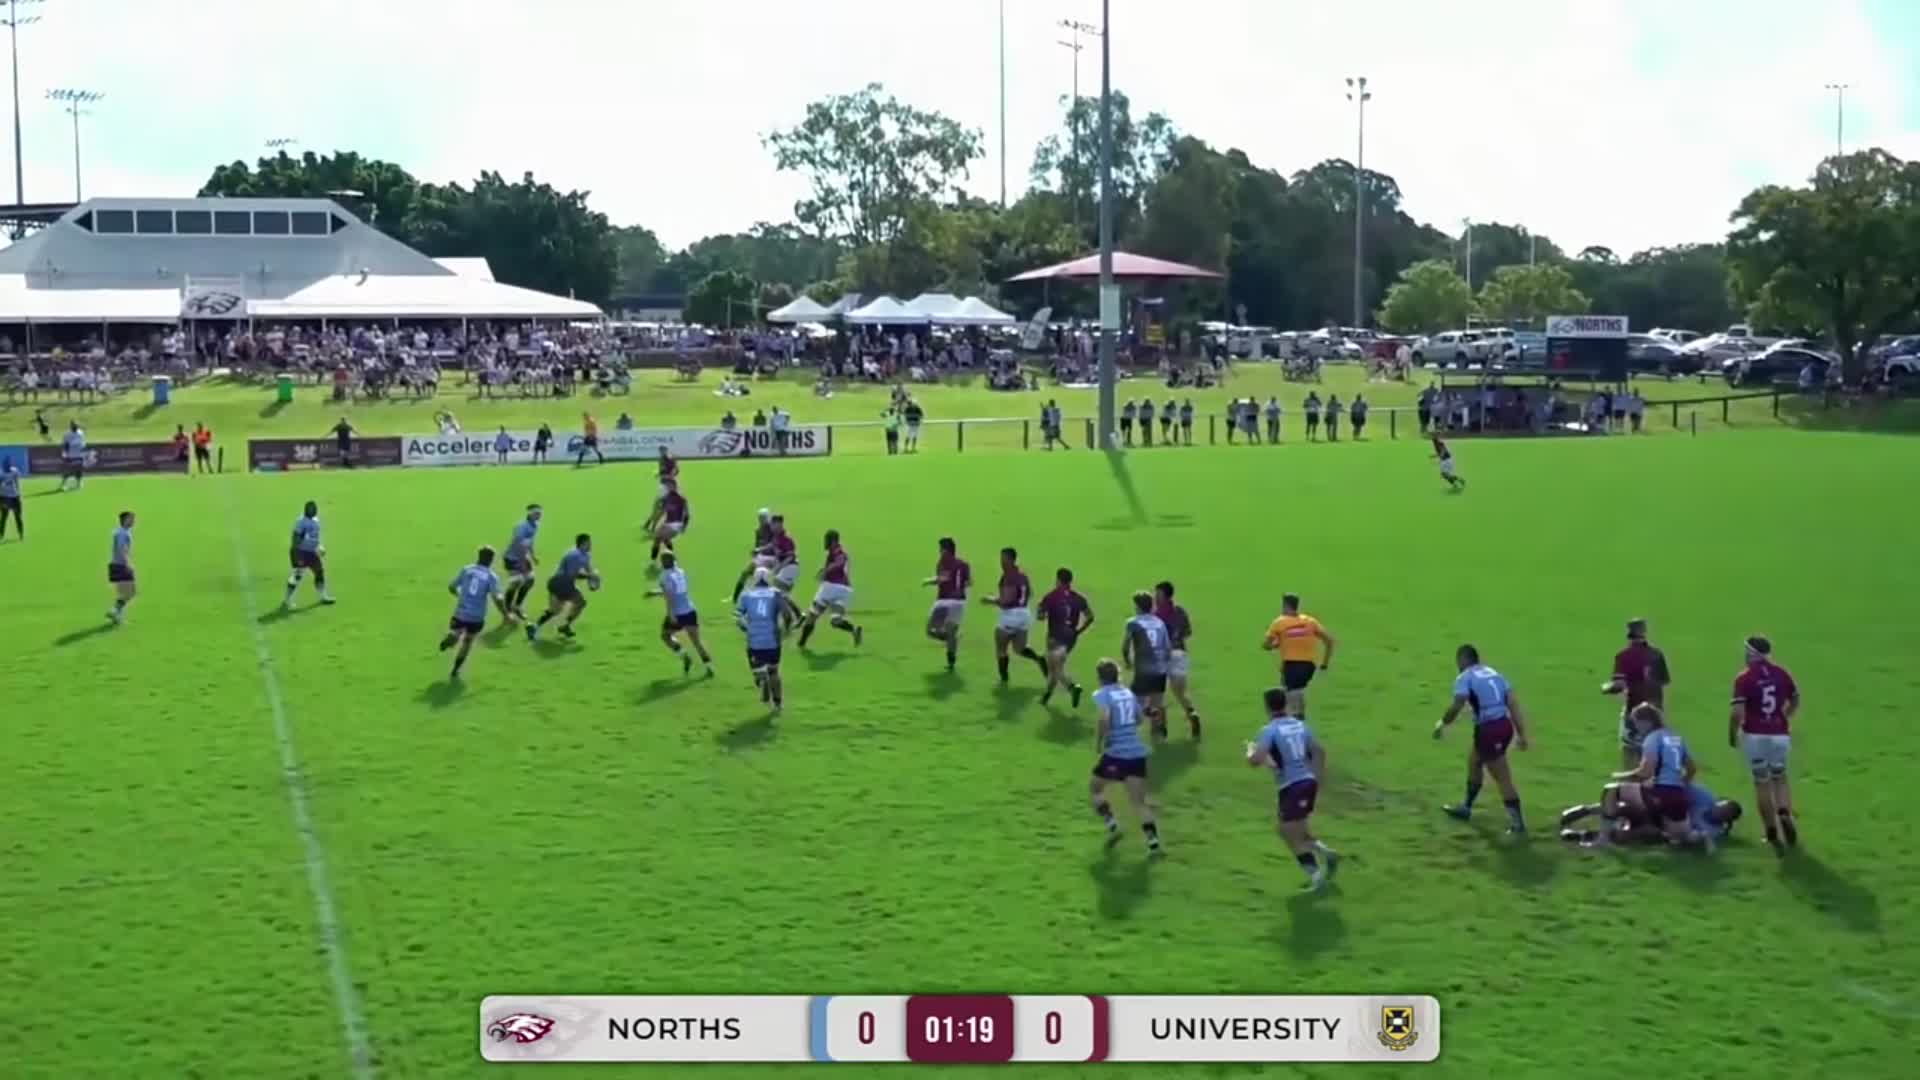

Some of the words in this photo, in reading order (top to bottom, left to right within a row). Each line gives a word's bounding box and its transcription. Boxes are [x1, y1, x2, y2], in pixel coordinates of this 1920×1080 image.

[1576, 318, 1622, 332] NORTHS
[408, 437, 530, 455] Accelerte
[744, 430, 815, 448] NOTHS
[1761, 685, 1777, 715] 5
[1117, 700, 1135, 725] 12
